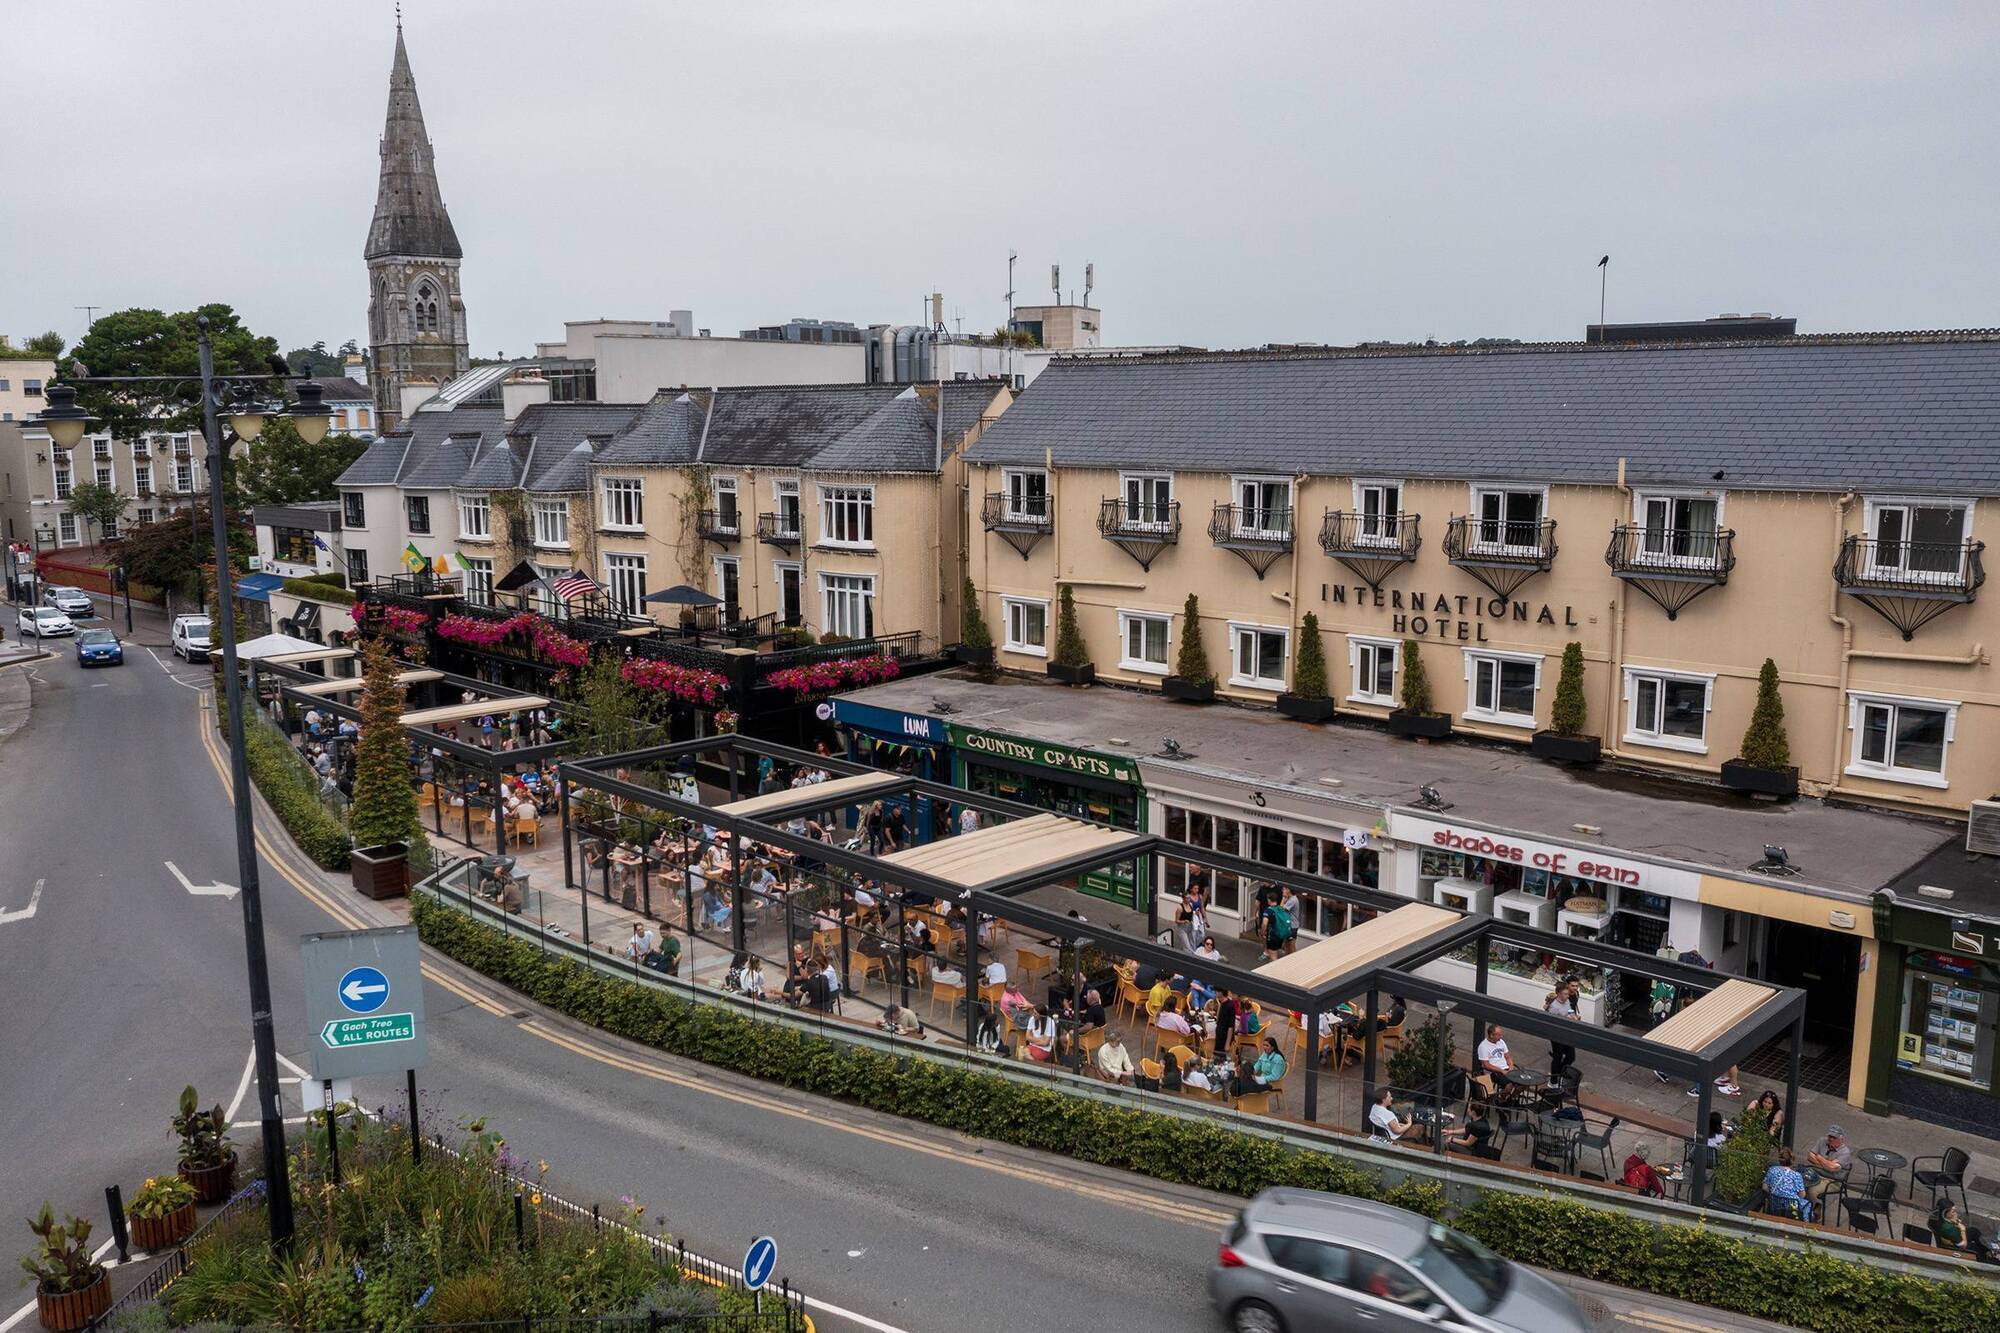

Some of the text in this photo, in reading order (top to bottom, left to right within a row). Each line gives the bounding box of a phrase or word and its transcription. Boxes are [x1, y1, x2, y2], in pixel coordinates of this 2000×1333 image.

[1321, 583, 1578, 627] INTERNATIONAL
[1393, 614, 1488, 642] HOTEL
[903, 716, 930, 738] LUNA
[966, 734, 1035, 760] COUNTRY
[1043, 750, 1110, 775] CRAFTS
[1532, 852, 1567, 874] of
[343, 1028, 409, 1042] ALL ROUTES
[371, 1020, 392, 1028] Treo
